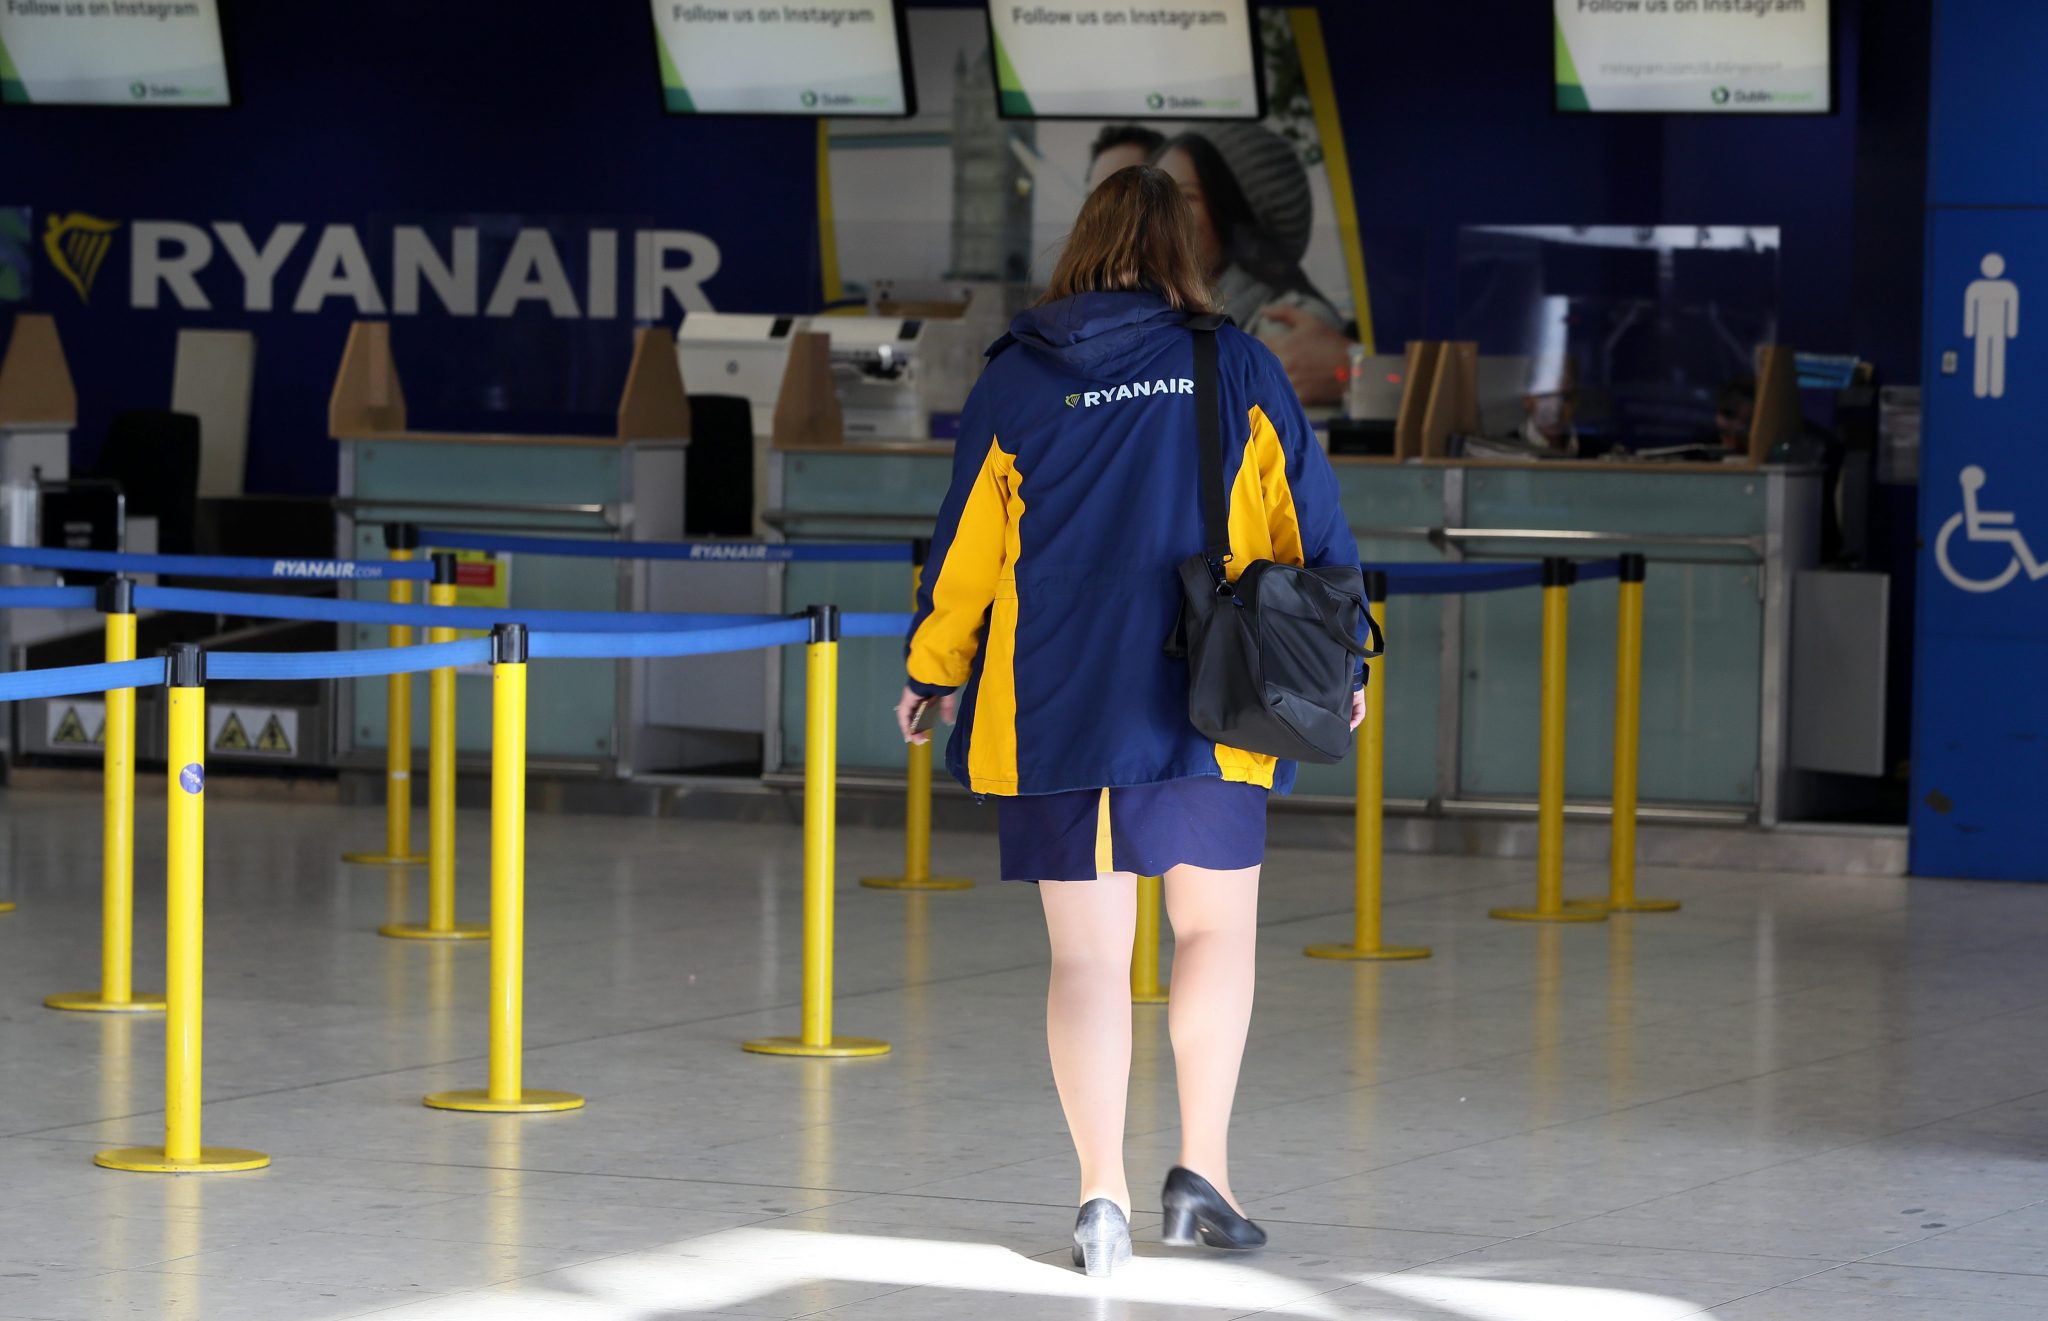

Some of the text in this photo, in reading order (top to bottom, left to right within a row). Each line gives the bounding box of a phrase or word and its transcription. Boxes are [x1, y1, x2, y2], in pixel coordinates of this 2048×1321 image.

[8, 0, 199, 22] Follow us on Instagram
[672, 5, 875, 27] Follow us on Instagram
[1012, 7, 1227, 30] Follow us on Instagram
[1577, 0, 1805, 17] Follow us on Instagram
[131, 220, 722, 319] RYANAIR
[1084, 377, 1195, 408] RYANAIR
